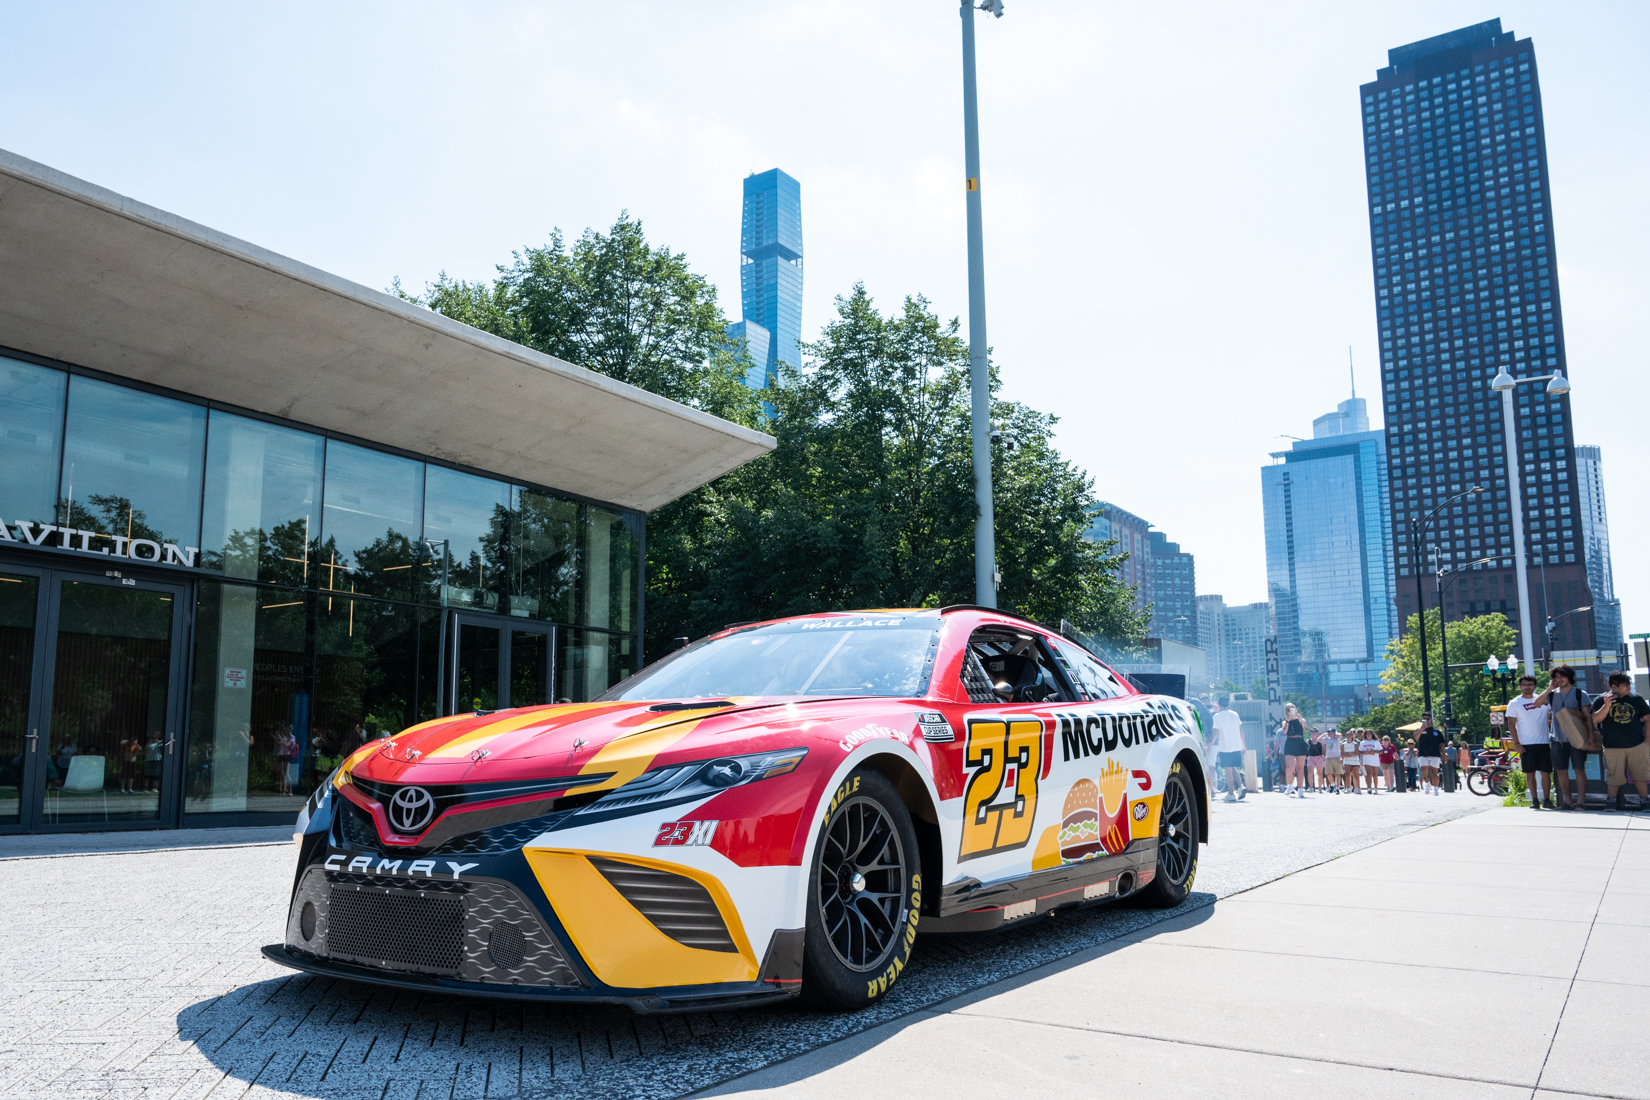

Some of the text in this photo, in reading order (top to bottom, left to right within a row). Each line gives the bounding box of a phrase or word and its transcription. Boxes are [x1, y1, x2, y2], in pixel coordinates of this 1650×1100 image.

[967, 179, 972, 190] 1
[801, 619, 902, 630] WALLACE
[1264, 635, 1282, 706] PIER
[1055, 700, 1193, 763] McDonald's
[823, 776, 861, 828] EAGLE
[957, 718, 1044, 864] 23
[651, 819, 721, 849] 23XI
[324, 854, 480, 880] CAMRY
